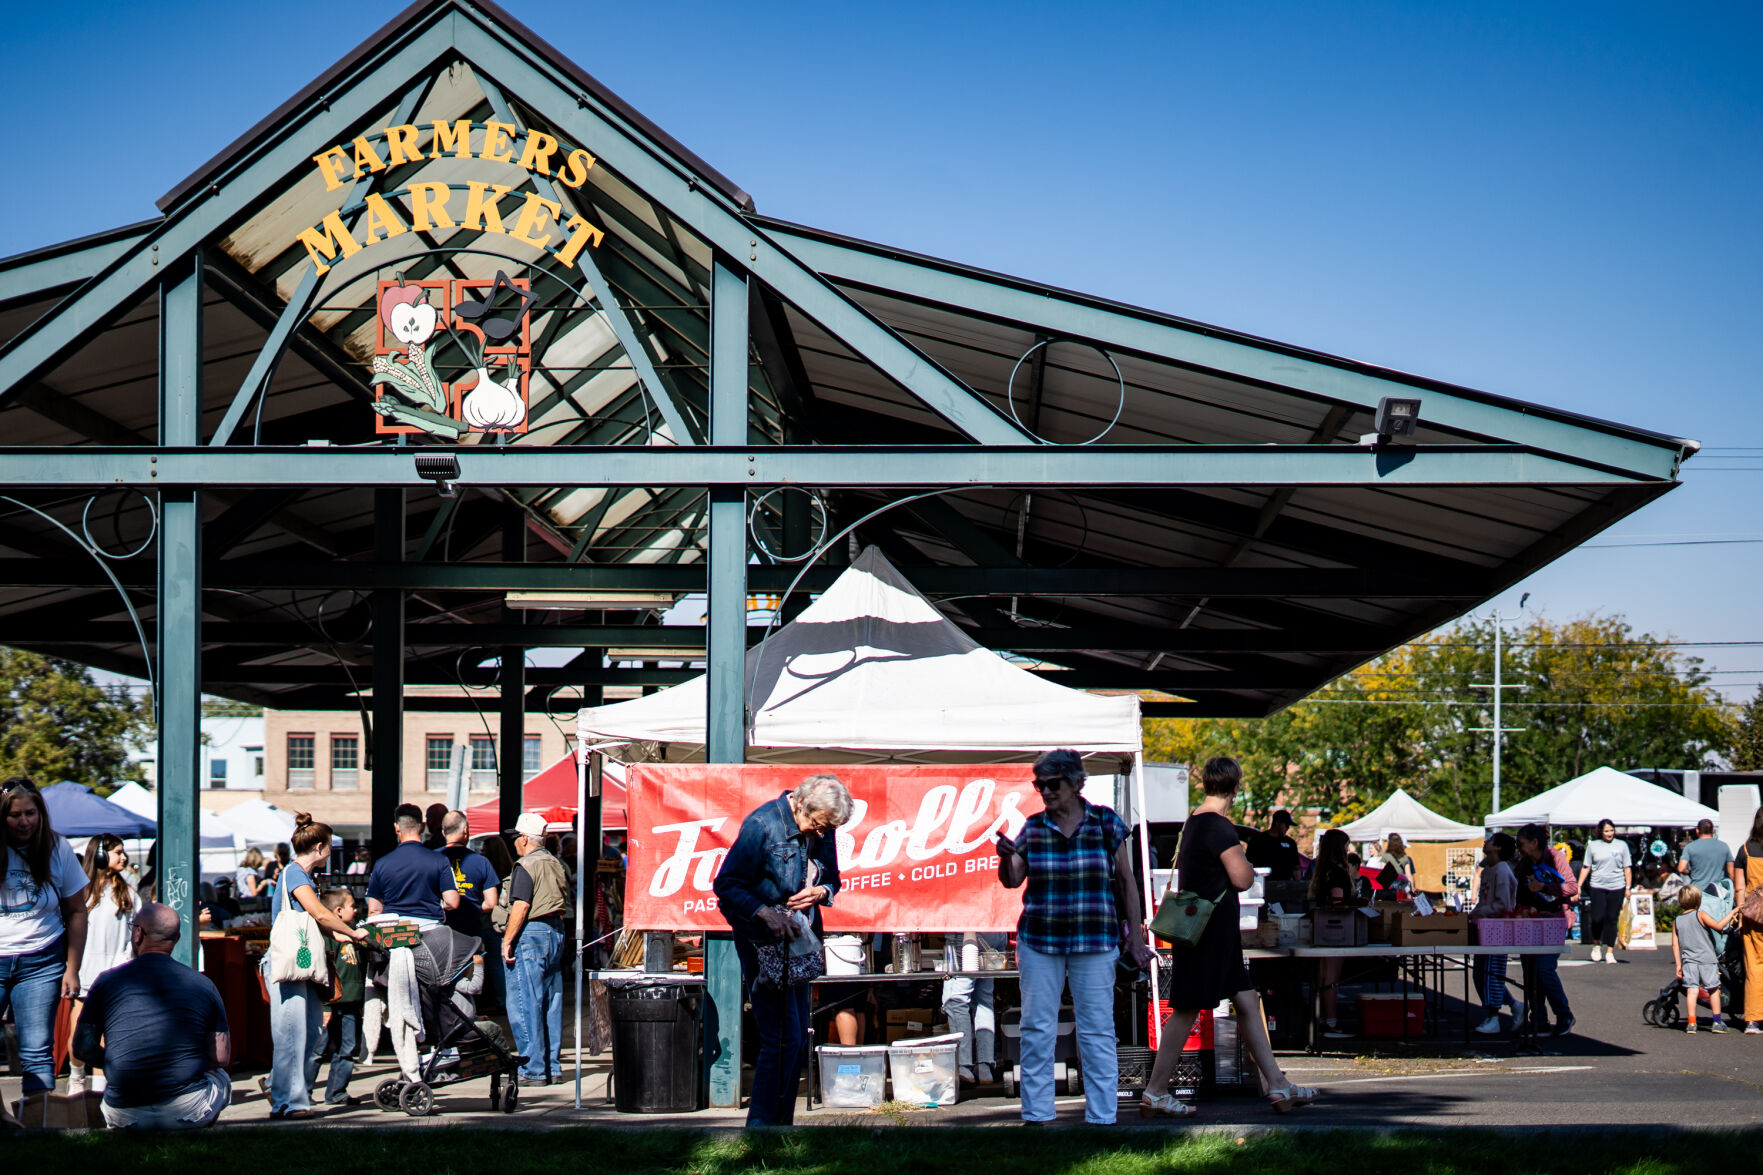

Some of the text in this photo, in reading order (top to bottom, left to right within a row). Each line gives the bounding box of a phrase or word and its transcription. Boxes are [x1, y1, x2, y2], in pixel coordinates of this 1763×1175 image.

[312, 120, 596, 192] FARMERS
[296, 180, 605, 277] MARKET
[839, 871, 892, 892] OFFEE
[911, 862, 957, 881] COLD
[964, 855, 1000, 873] BRE
